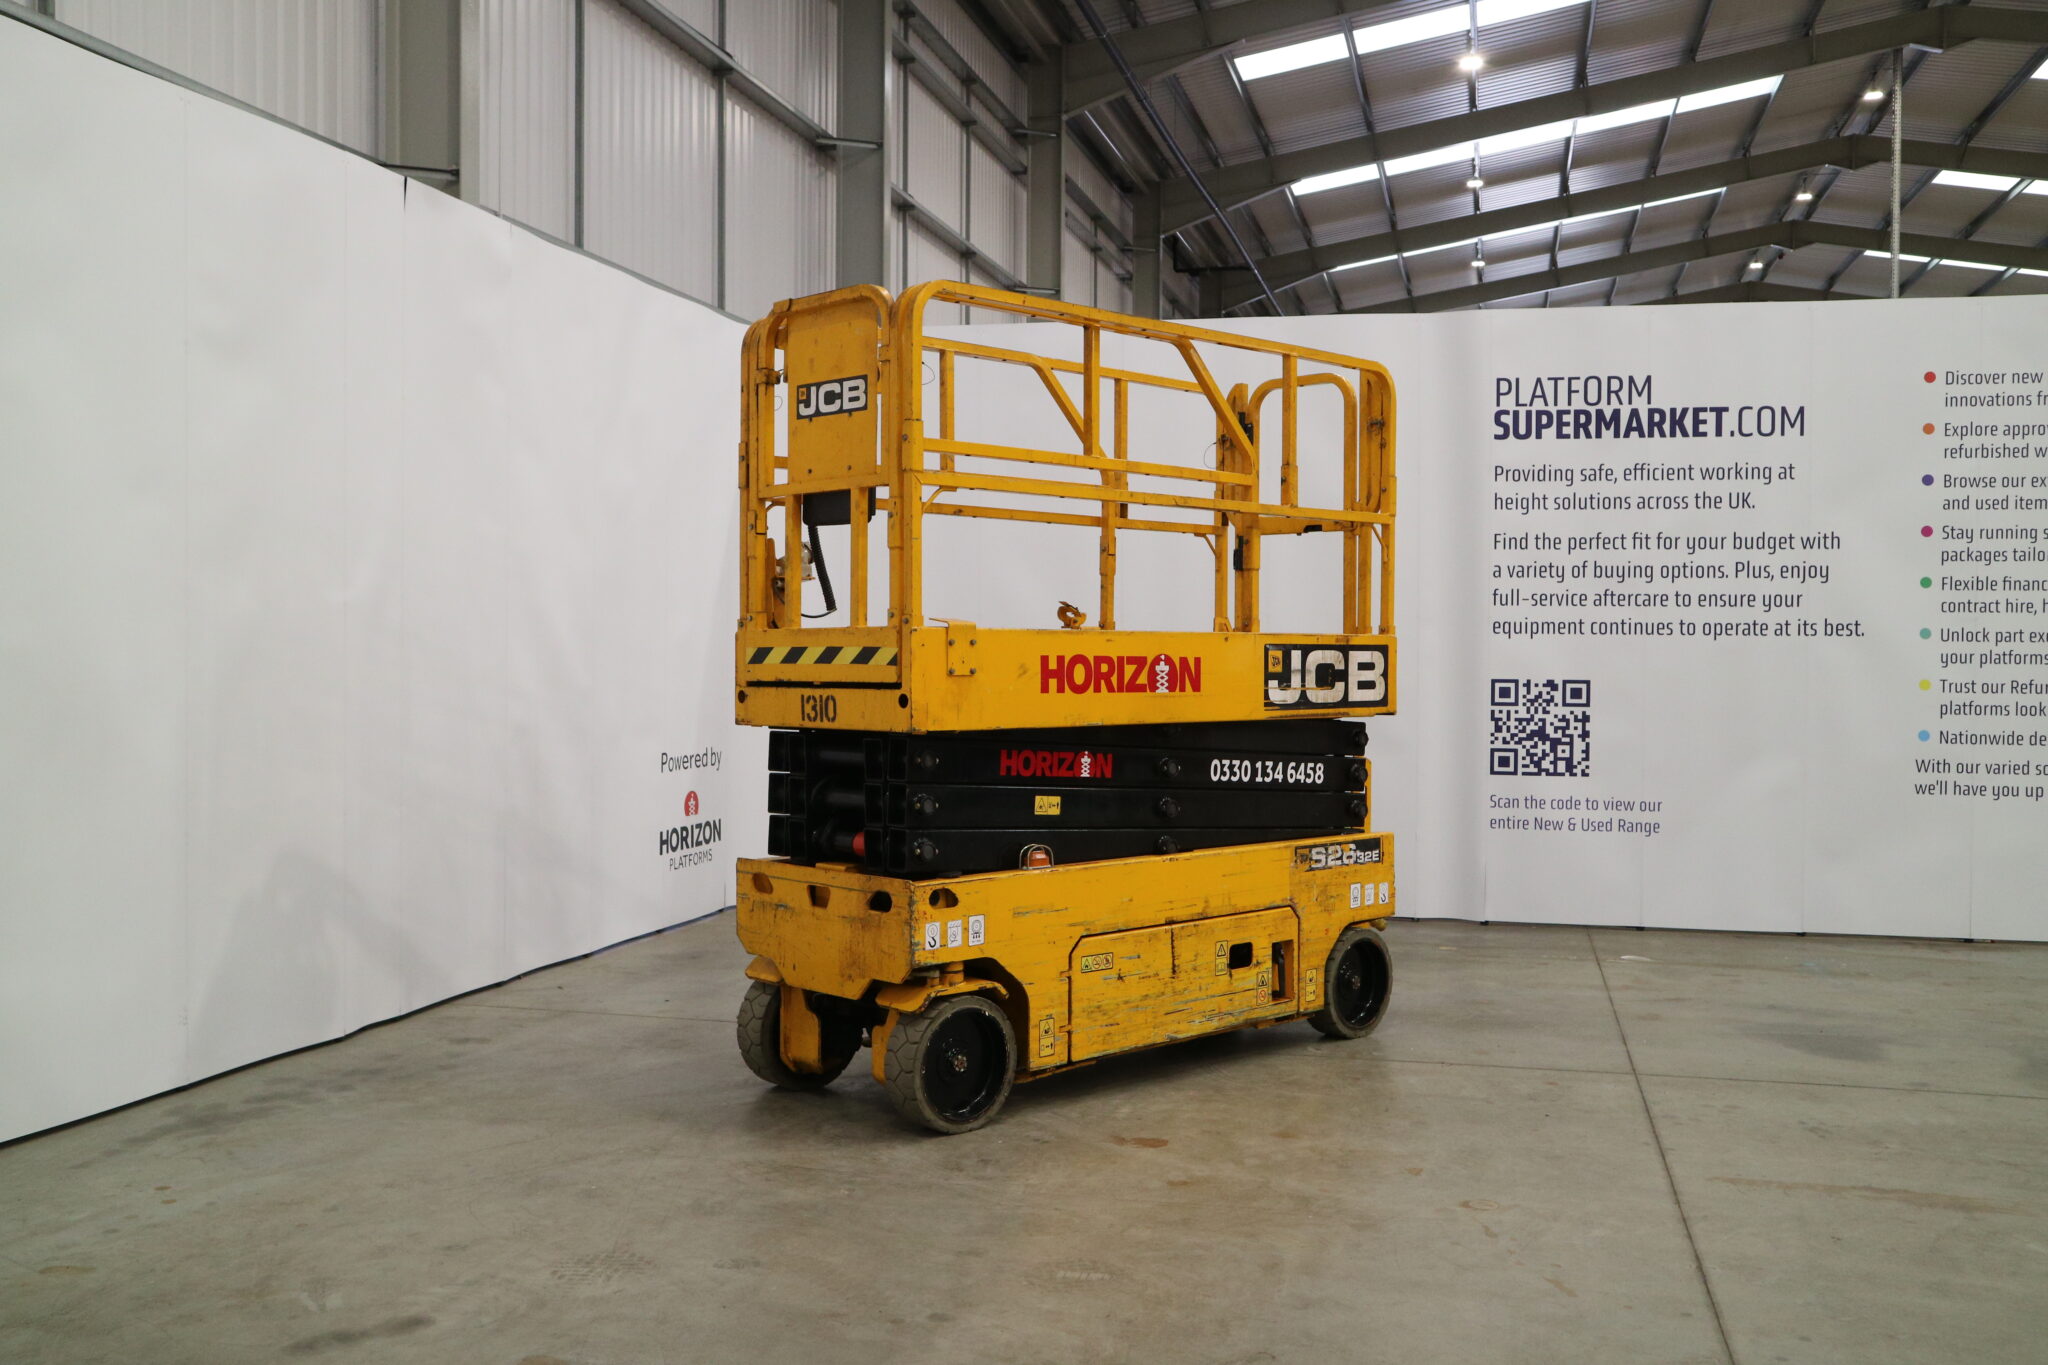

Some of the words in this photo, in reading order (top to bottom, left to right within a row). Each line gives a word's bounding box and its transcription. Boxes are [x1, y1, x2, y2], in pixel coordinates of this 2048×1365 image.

[1946, 370, 2006, 385] Discover
[2012, 373, 2043, 384] new
[799, 379, 866, 416] JCB
[1496, 375, 1651, 407] PLATFORM
[1946, 392, 2031, 407] innovations
[1494, 405, 1804, 440] SUPERMARKET.COM
[1945, 421, 1998, 440] Explore
[2003, 425, 2048, 440] appro
[1945, 443, 2029, 458] refurbished
[1495, 464, 1573, 486] Providing
[1581, 464, 1617, 484] safe,
[1624, 463, 1694, 481] efficient
[1700, 462, 1771, 485] working
[1778, 464, 1795, 480] at
[1944, 474, 1996, 488] Browse
[2002, 477, 2026, 487] our
[1495, 493, 1548, 515] height
[1554, 492, 1631, 510] solutions
[1637, 496, 1688, 509] across
[1695, 491, 1722, 509] the
[1729, 492, 1755, 509] UK.
[1943, 495, 1969, 510] and
[1976, 495, 2008, 510] used
[1494, 532, 1528, 550] Find
[1535, 533, 1561, 550] the
[1568, 532, 1626, 555] perfect
[1632, 532, 1651, 550] fit
[1657, 532, 1680, 550] for
[1687, 537, 1726, 554] your
[1734, 532, 1795, 554] budget
[1801, 531, 1840, 549] with
[1943, 525, 1973, 543] Stay
[1980, 525, 2037, 543] running
[1942, 547, 2007, 566] packages
[2013, 547, 2048, 561] tailo
[1493, 565, 1501, 578] a
[1507, 561, 1564, 583] variety
[1572, 561, 1588, 578] of
[1594, 561, 1653, 583] buying
[1661, 561, 1728, 583] options.
[1736, 561, 1774, 581] Plus,
[1781, 561, 1828, 583] enjoy
[1942, 576, 1997, 591] Flexible
[1493, 589, 1587, 606] full-service
[1594, 589, 1668, 607] aftercare
[1675, 591, 1691, 607] to
[1698, 594, 1755, 607] ensure
[1763, 594, 1802, 612] your
[1941, 600, 2000, 613] contract
[2006, 598, 2037, 615] hire,
[1493, 617, 1584, 639] equipment
[1591, 618, 1673, 635] continues
[1679, 620, 1695, 635] to
[1703, 620, 1768, 640] operate
[1775, 620, 1791, 636] at
[1798, 619, 1817, 636] its
[1825, 618, 1864, 636] best.
[1941, 627, 1989, 642] Unlock
[1996, 629, 2024, 646] part
[2030, 632, 2048, 642] ex
[1941, 653, 1974, 668] your
[1040, 653, 1201, 694] HORIZON
[1268, 650, 1385, 704] JCB
[1940, 680, 1976, 693] Trust
[1982, 683, 2005, 694] our
[801, 694, 837, 723] 1310
[1940, 701, 2009, 719] platforms
[2016, 702, 2046, 716] look
[1940, 730, 2023, 745] Nationwide
[661, 747, 708, 773] Powered
[711, 747, 721, 771] by
[1000, 750, 1113, 778] HORIZON
[1916, 759, 1950, 773] With
[1957, 763, 1980, 774] our
[1985, 760, 2029, 775] varied
[1210, 758, 1251, 782] 0330
[1255, 760, 1284, 783] 134
[1287, 761, 1325, 784] 6458
[1915, 780, 1947, 795] we'll
[1954, 781, 1986, 796] have
[1993, 786, 2019, 800] you
[2026, 787, 2043, 801] up
[1490, 795, 1519, 808] Scan
[1524, 795, 1545, 809] the
[1551, 796, 1581, 810] code
[1586, 798, 1598, 810] to
[1603, 797, 1635, 811] view
[1640, 801, 1662, 812] our
[659, 818, 721, 855] HORIZON
[1490, 816, 1529, 830] entire
[1535, 817, 1563, 830] New
[1568, 818, 1576, 831] &
[1582, 818, 1612, 832] Used
[1618, 819, 1660, 837] Range
[669, 849, 713, 871] PLATFORMS
